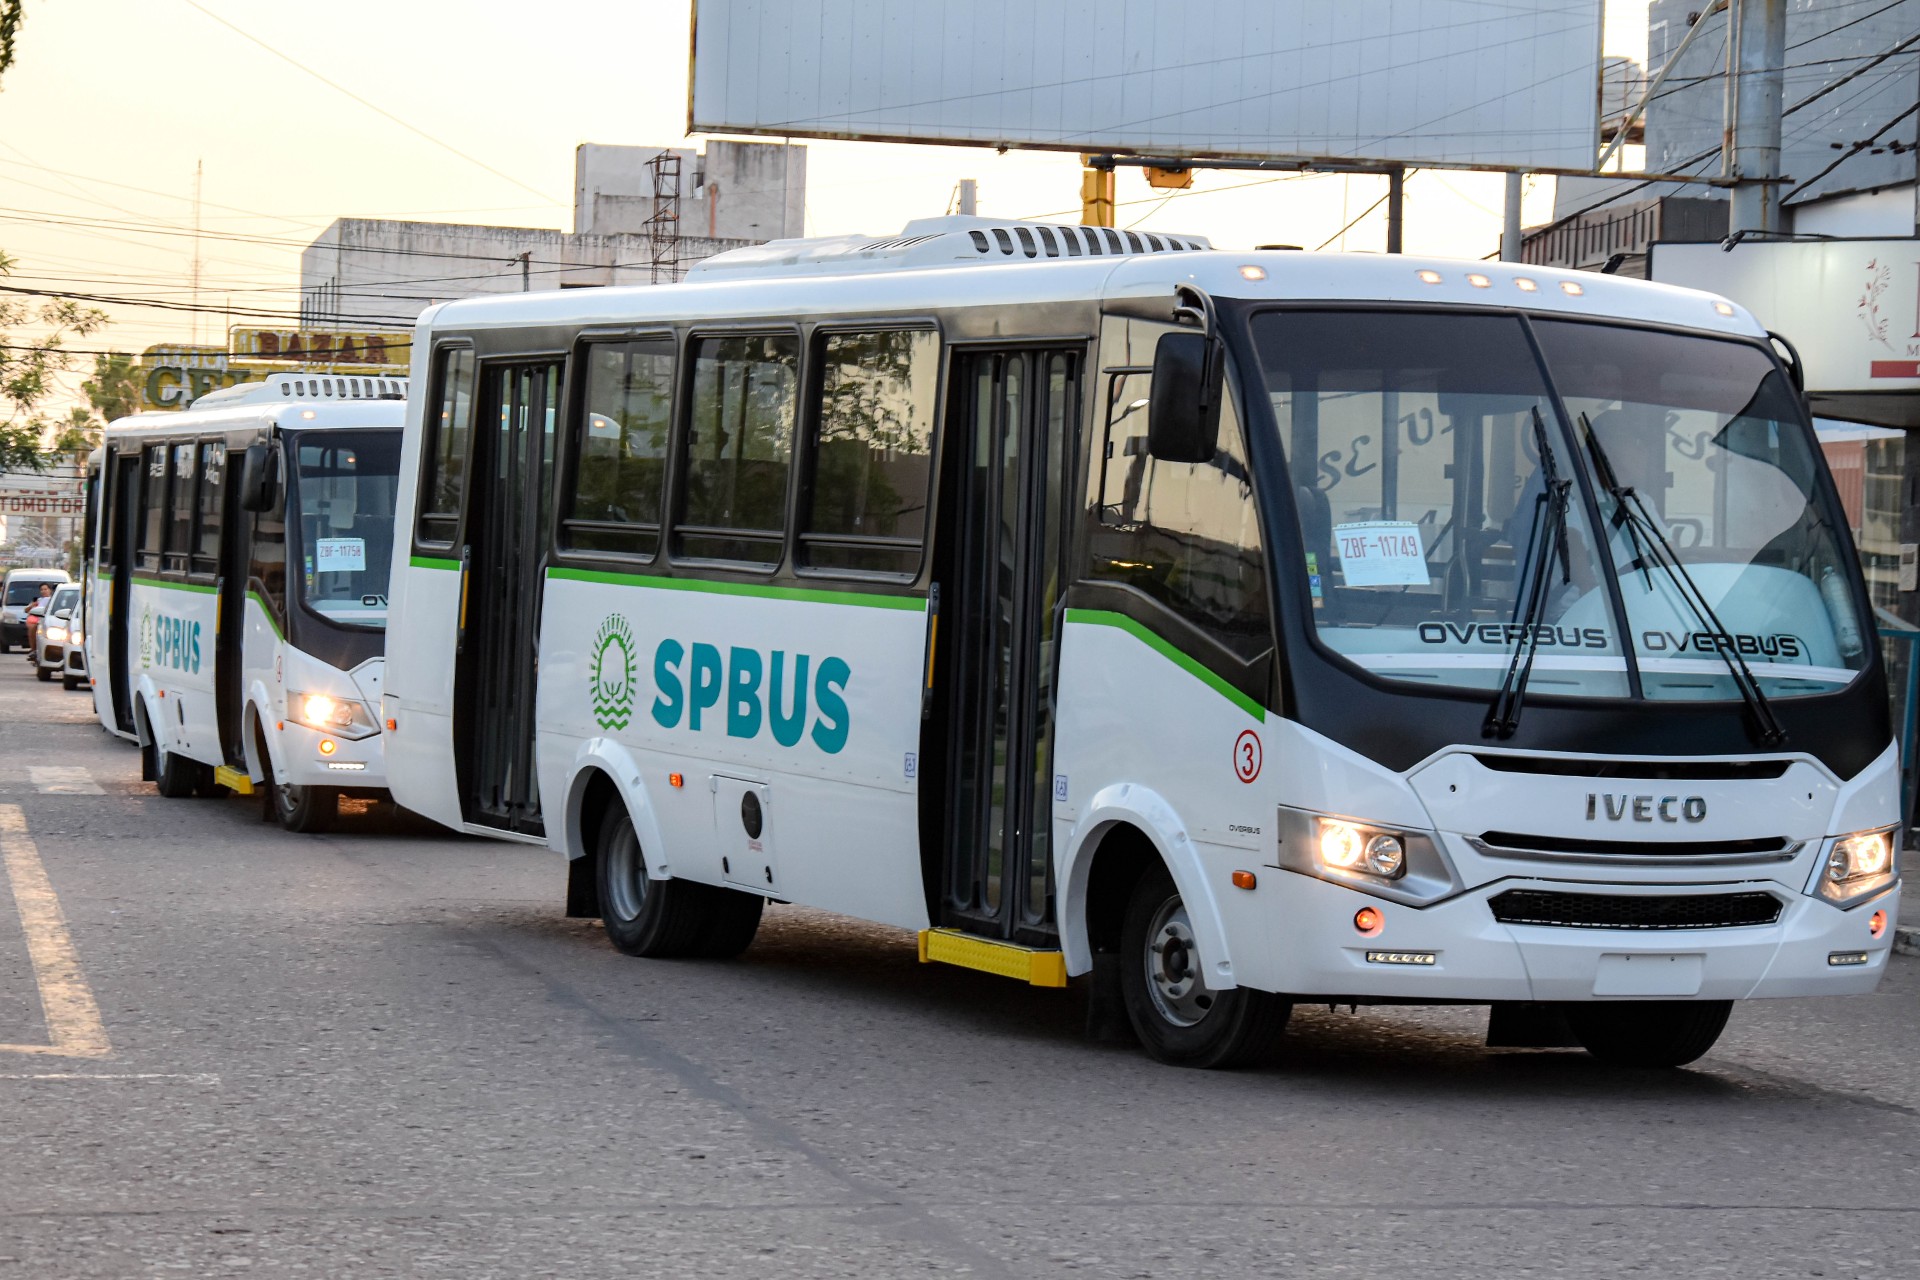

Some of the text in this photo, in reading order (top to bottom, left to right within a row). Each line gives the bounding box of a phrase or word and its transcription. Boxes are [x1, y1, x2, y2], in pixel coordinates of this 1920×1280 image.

[258, 332, 390, 364] BAZAR
[1341, 535, 1418, 559] ZBF-11749
[155, 614, 201, 674] SPBUS
[1420, 623, 1608, 648] OVERBUS
[1643, 631, 1800, 657] OVERBUS
[652, 638, 851, 755] SPBUS
[1242, 742, 1253, 776] 3
[1586, 793, 1707, 823] IVECO
